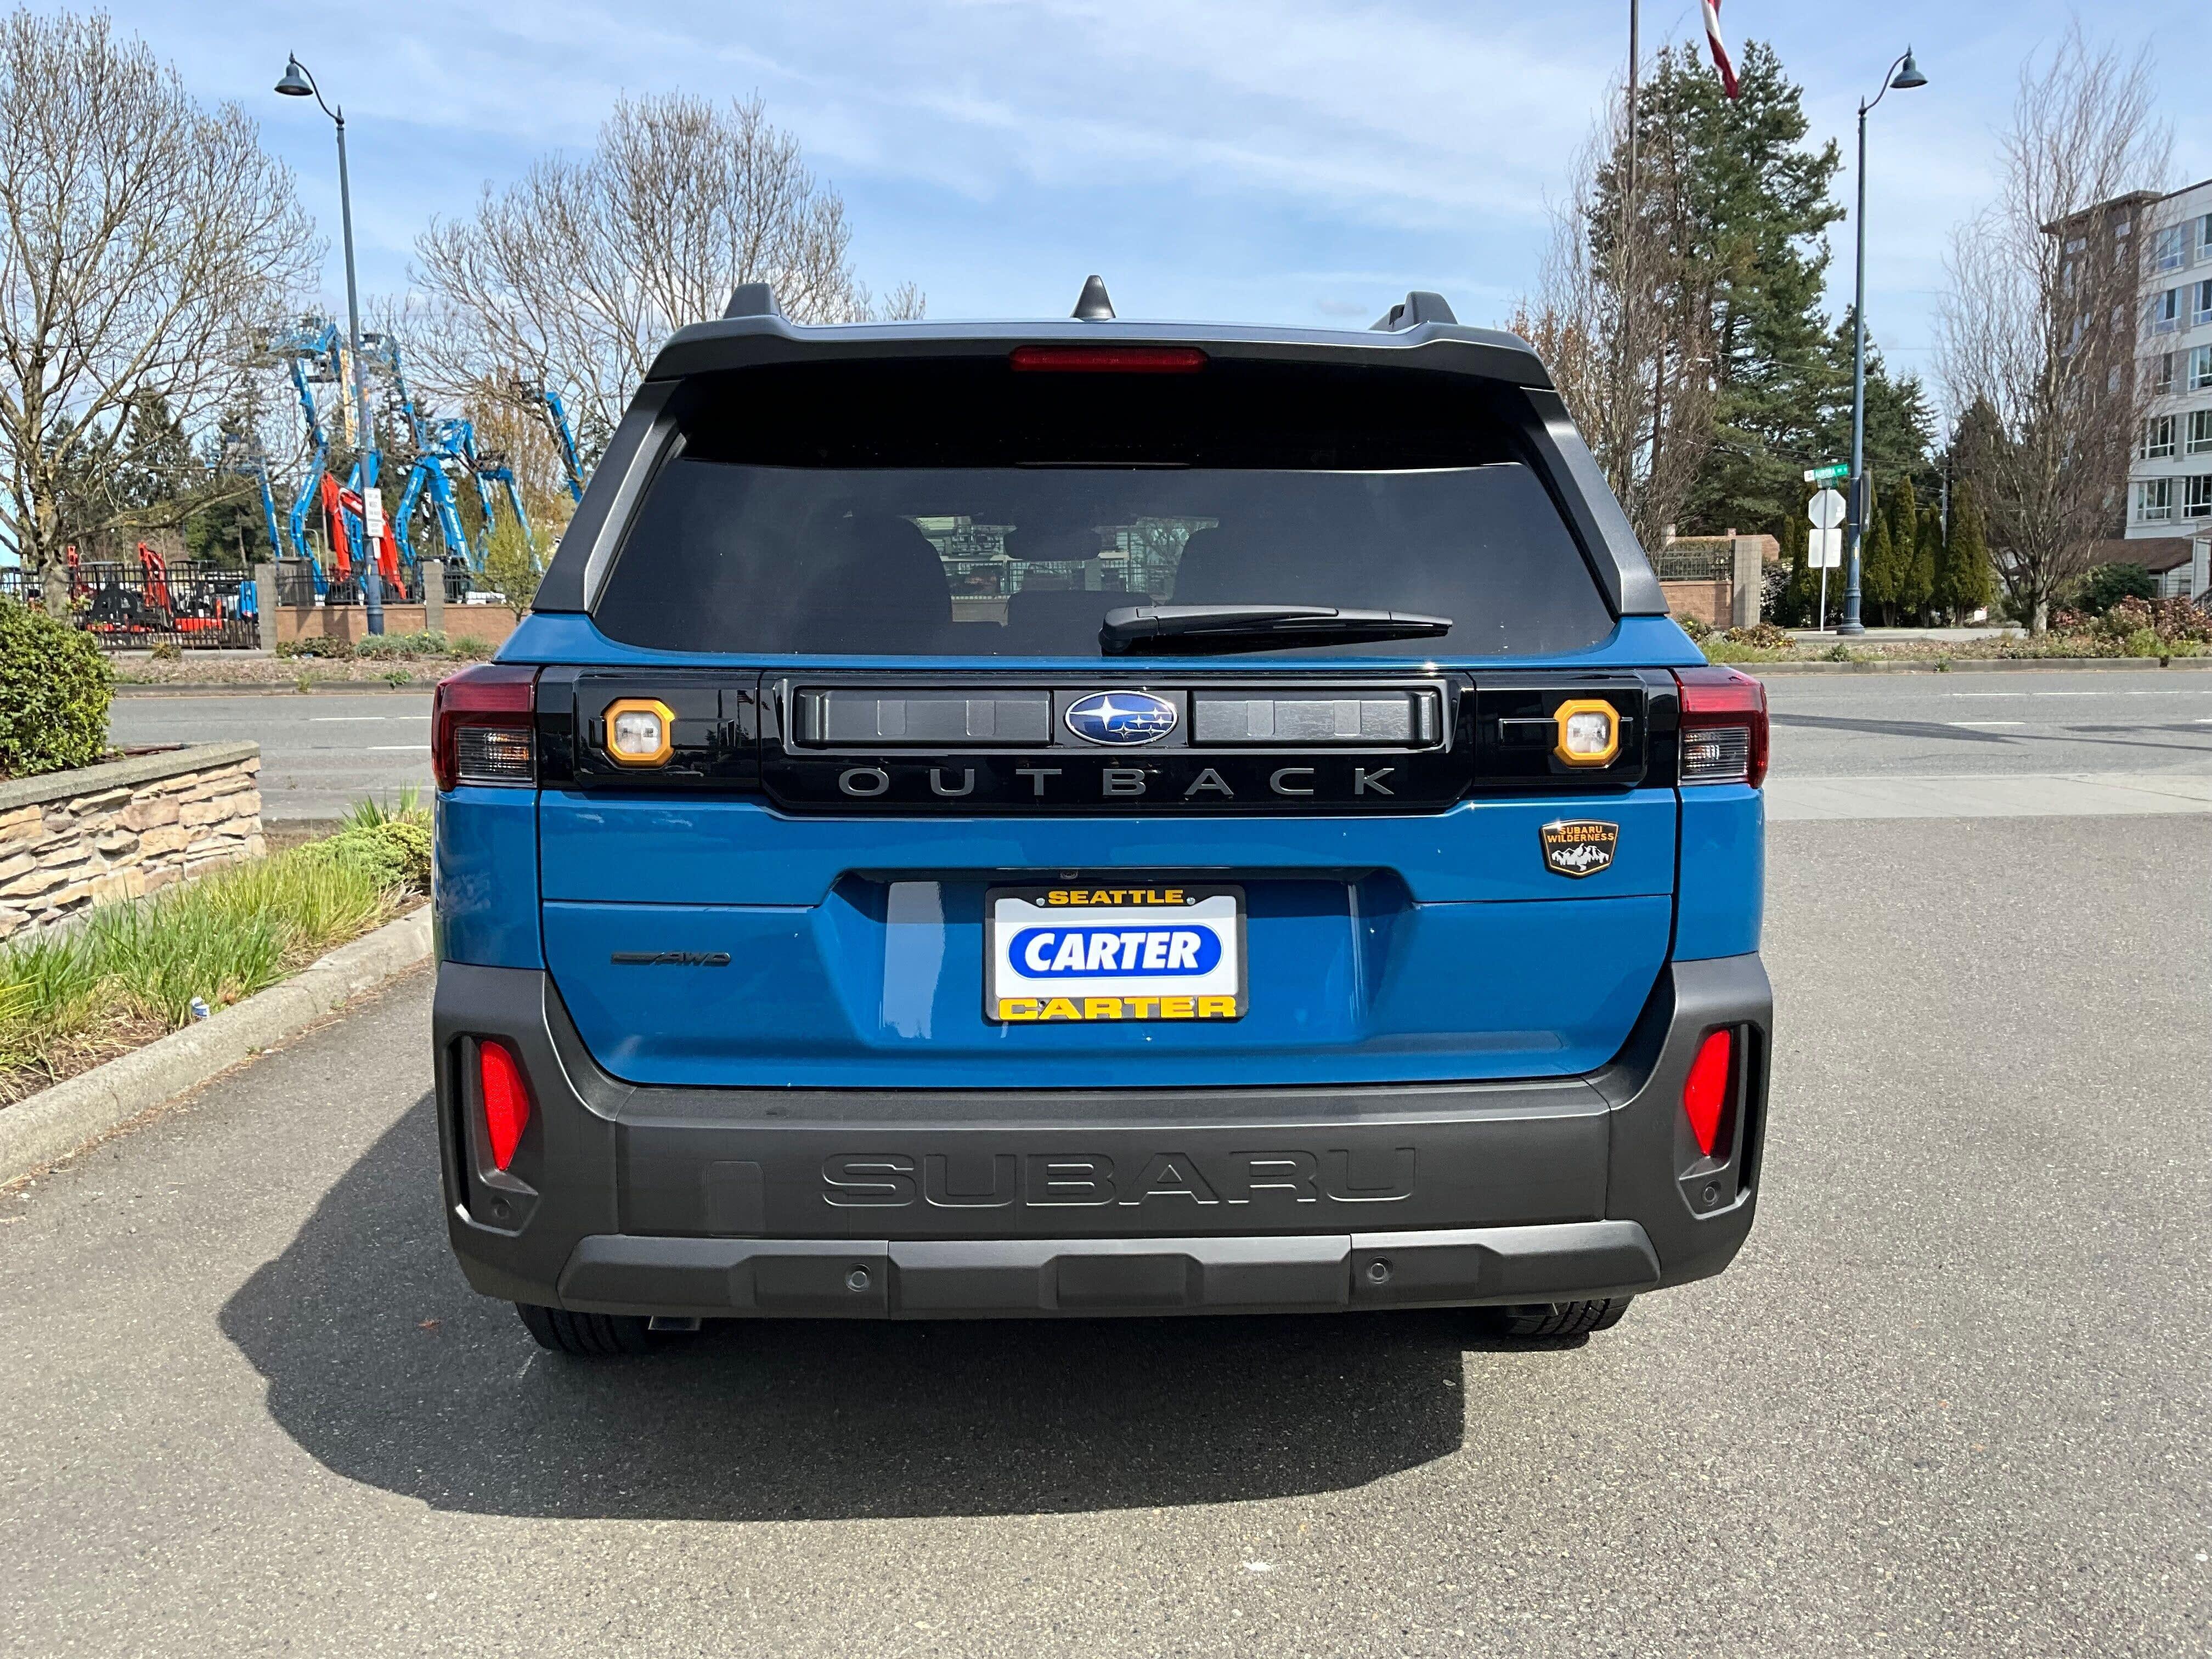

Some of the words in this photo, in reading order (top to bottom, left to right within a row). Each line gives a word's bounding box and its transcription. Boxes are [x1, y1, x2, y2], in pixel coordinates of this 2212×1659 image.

[838, 767, 1395, 798] OUTBACK
[1547, 833, 1615, 843] WILDERNESS
[1559, 826, 1603, 834] SUBARU
[1047, 890, 1184, 905] SEATTLE
[656, 951, 731, 963] AWD
[1024, 931, 1201, 972] CARTER
[998, 996, 1237, 1020] CARTER
[822, 1148, 1415, 1206] SUBARU
